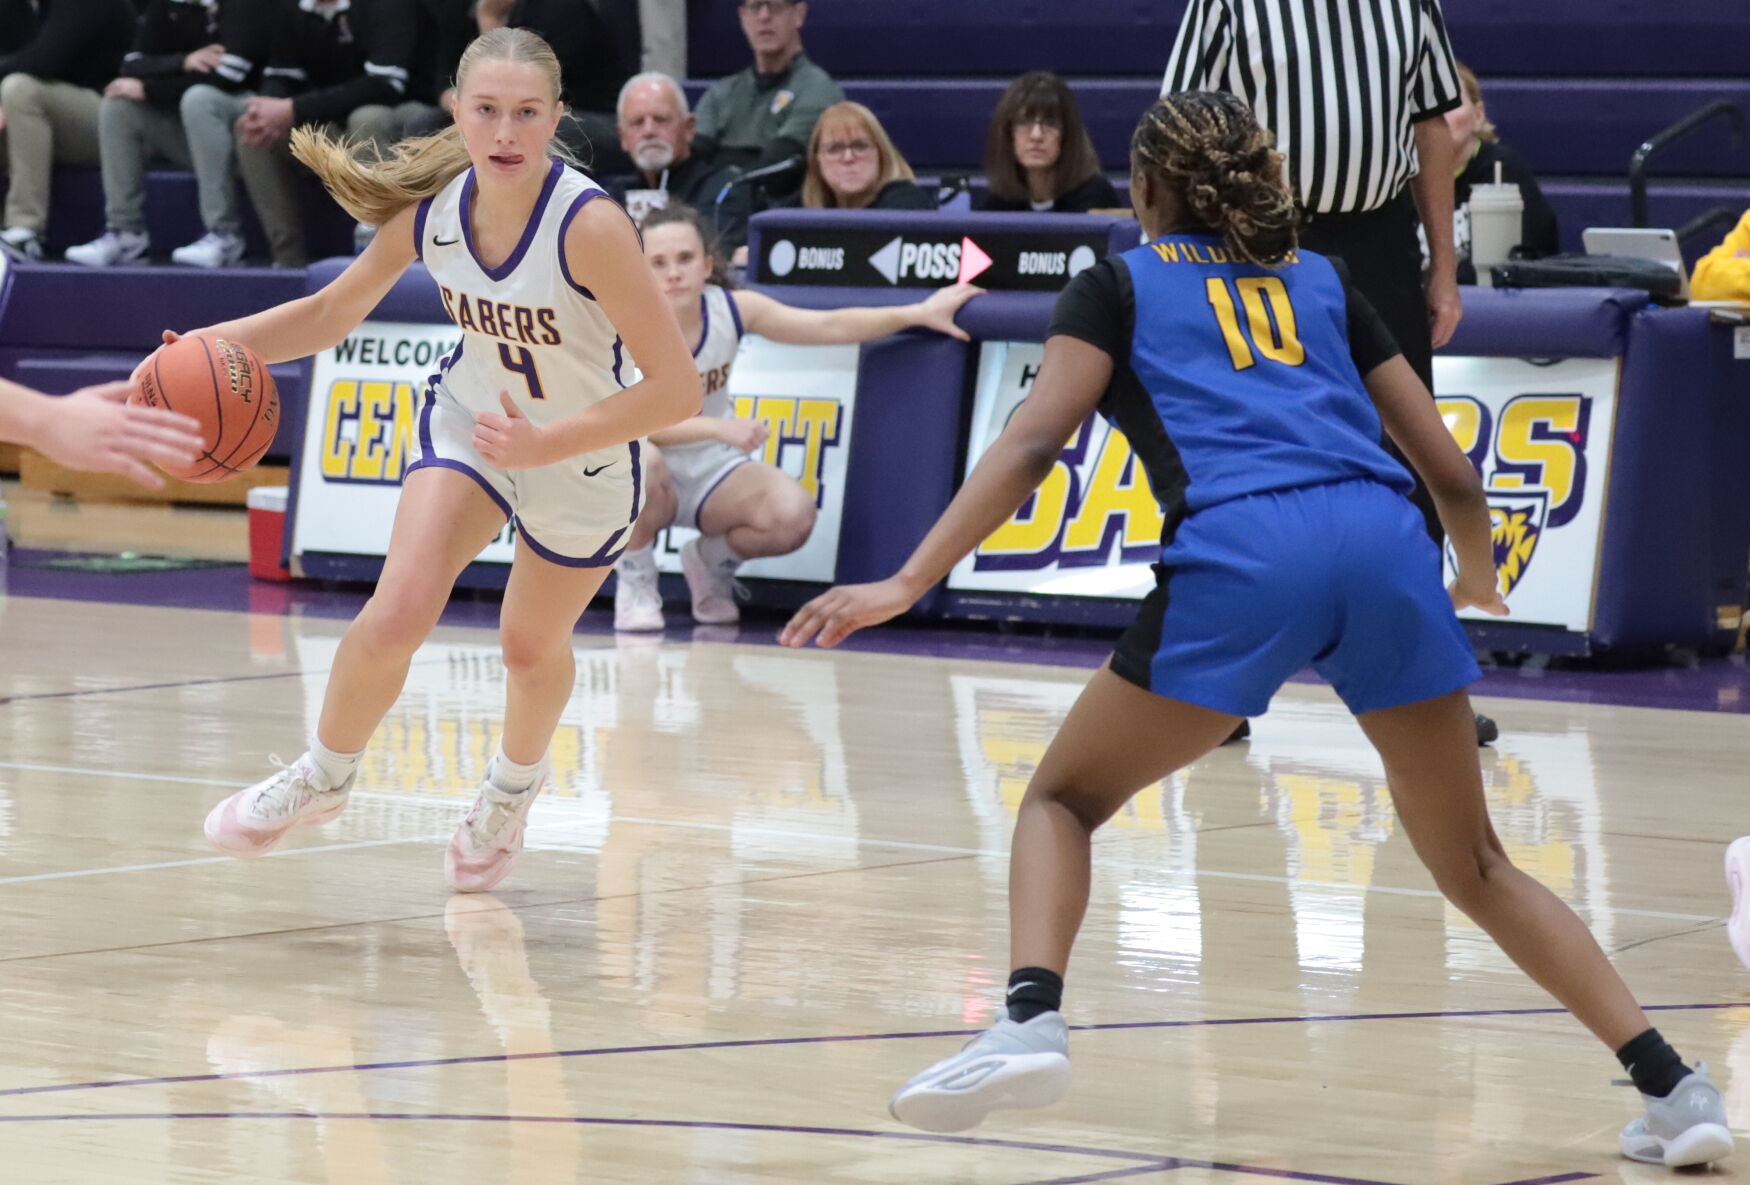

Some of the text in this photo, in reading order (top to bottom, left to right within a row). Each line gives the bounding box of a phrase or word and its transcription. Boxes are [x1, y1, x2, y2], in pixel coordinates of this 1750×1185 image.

[798, 248, 845, 271] BONUS
[900, 242, 962, 280] POSS
[1017, 252, 1067, 275] BONUS
[440, 285, 562, 346] SABERS
[1205, 276, 1307, 372] 10
[334, 336, 455, 366] WELCOM
[497, 341, 548, 400] 4
